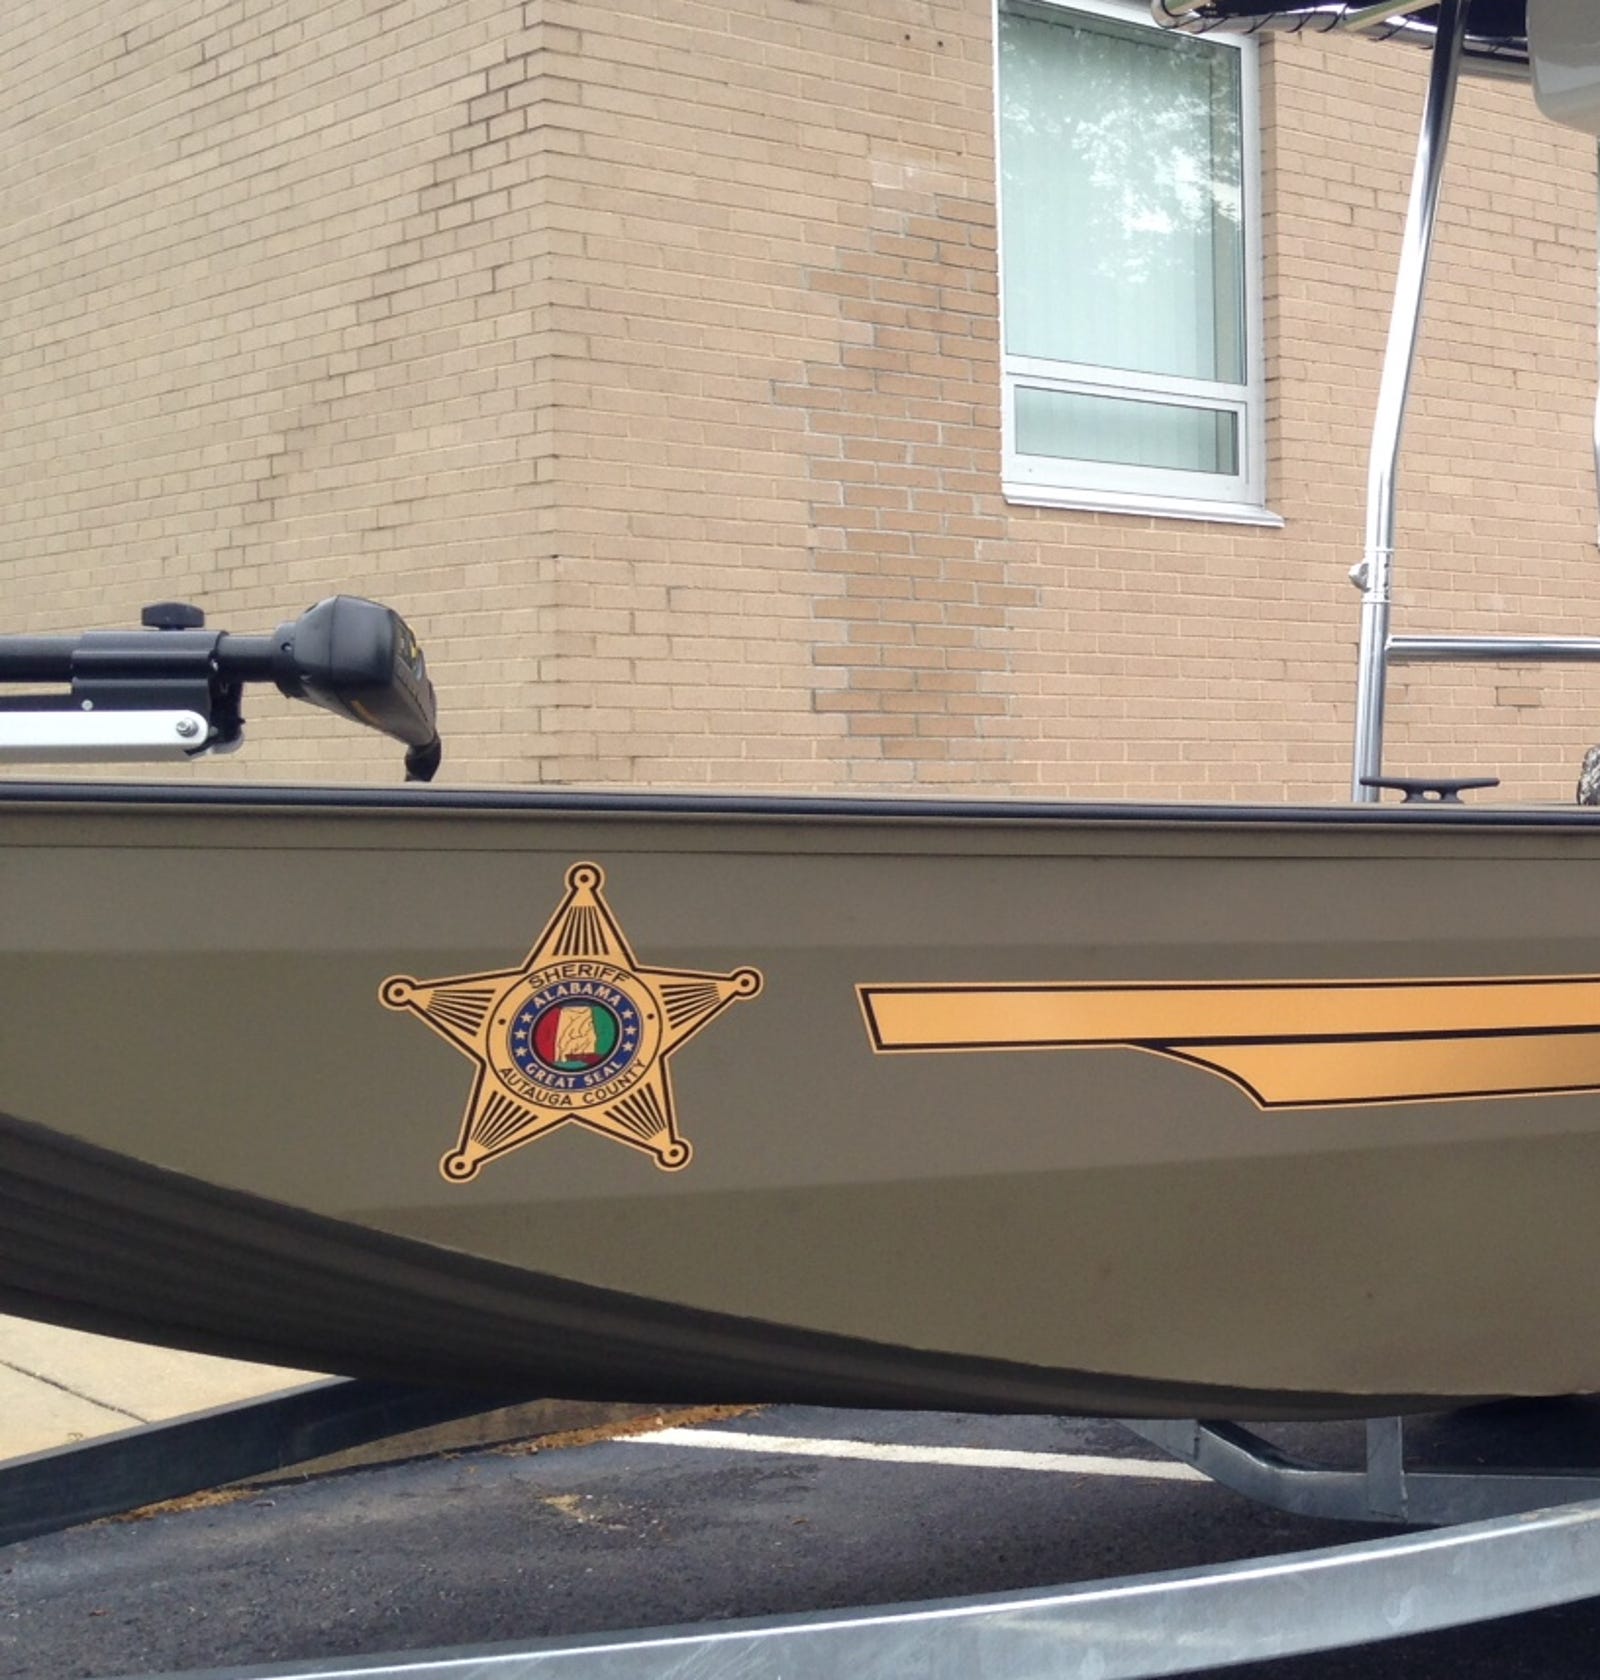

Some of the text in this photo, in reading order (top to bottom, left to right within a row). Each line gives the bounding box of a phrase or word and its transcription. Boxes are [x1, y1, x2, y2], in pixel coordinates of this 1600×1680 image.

[528, 964, 630, 989] SHERIFF
[533, 982, 622, 1009] ALABAMA
[499, 1058, 646, 1106] AUTAUGA COUNTY
[525, 1060, 623, 1088] GREAT SEAL
